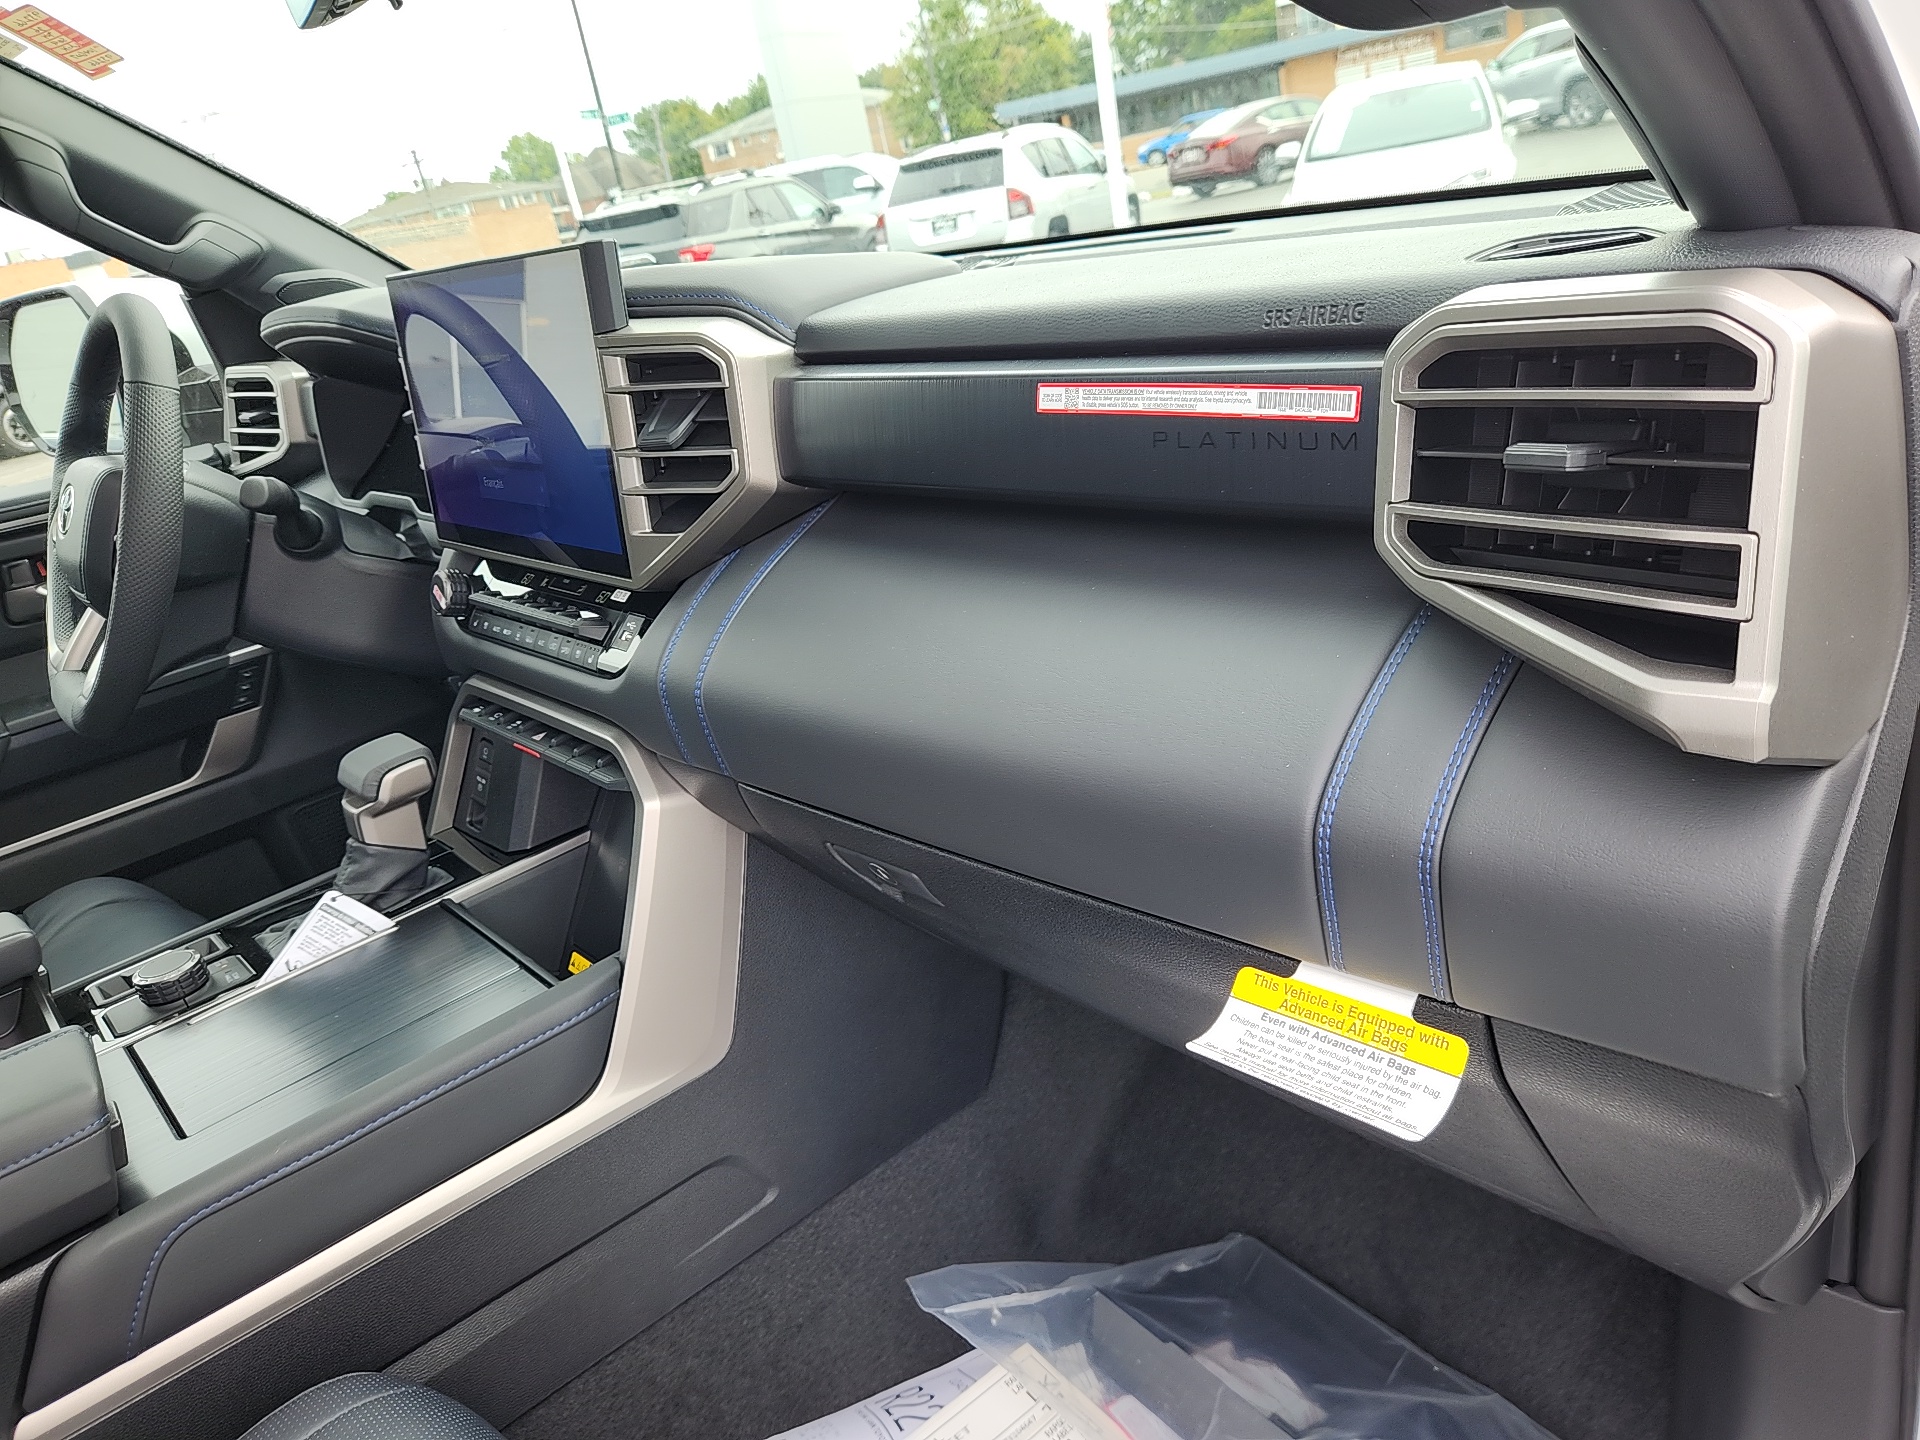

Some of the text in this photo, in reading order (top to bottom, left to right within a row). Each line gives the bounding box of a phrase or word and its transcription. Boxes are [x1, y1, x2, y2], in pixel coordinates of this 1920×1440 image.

[1262, 302, 1365, 329] SRS AIRBAG
[1152, 431, 1358, 451] PLATINUM
[1254, 973, 1450, 1051] This Vehicle is Equipped with
[1279, 999, 1408, 1052] Advanced Air Bags
[1230, 1013, 1260, 1030] Children
[1261, 1026, 1274, 1036] can
[1275, 1030, 1286, 1039] be
[1287, 1035, 1307, 1048] killed
[1317, 1047, 1352, 1066] seriously
[1353, 1059, 1382, 1075] injured
[1383, 1070, 1394, 1081] by
[1395, 1075, 1409, 1086] the
[1410, 1081, 1422, 1090] air
[1423, 1085, 1442, 1099] bag.
[1236, 1047, 1261, 1059] Always
[1262, 1058, 1277, 1066] use
[1278, 1064, 1295, 1073] seat
[1296, 1070, 1315, 1081] belts
[1316, 1079, 1334, 1088] and
[1333, 1085, 1354, 1096] child
[1244, 1029, 1258, 1040] The
[1258, 1035, 1276, 1047] back
[1277, 1044, 1294, 1054] seat
[1303, 1052, 1316, 1062] the
[1317, 1060, 1341, 1071] safest
[1341, 1068, 1364, 1080] place
[1366, 1075, 1377, 1085] for
[1378, 1081, 1412, 1099] children.
[1260, 1012, 1417, 1076] Even with Advanced Air Bags
[1238, 1038, 1259, 1050] Never
[1259, 1047, 1272, 1056] put
[1280, 1055, 1320, 1075] rear-facing
[1321, 1070, 1341, 1082] child
[1341, 1079, 1360, 1089] seat
[1370, 1089, 1384, 1099] the
[1386, 1094, 1407, 1109] front.
[1311, 1085, 1355, 1105] information
[1356, 1103, 1381, 1116] about
[1381, 1111, 1394, 1121] air
[1395, 1119, 1418, 1131] bags.
